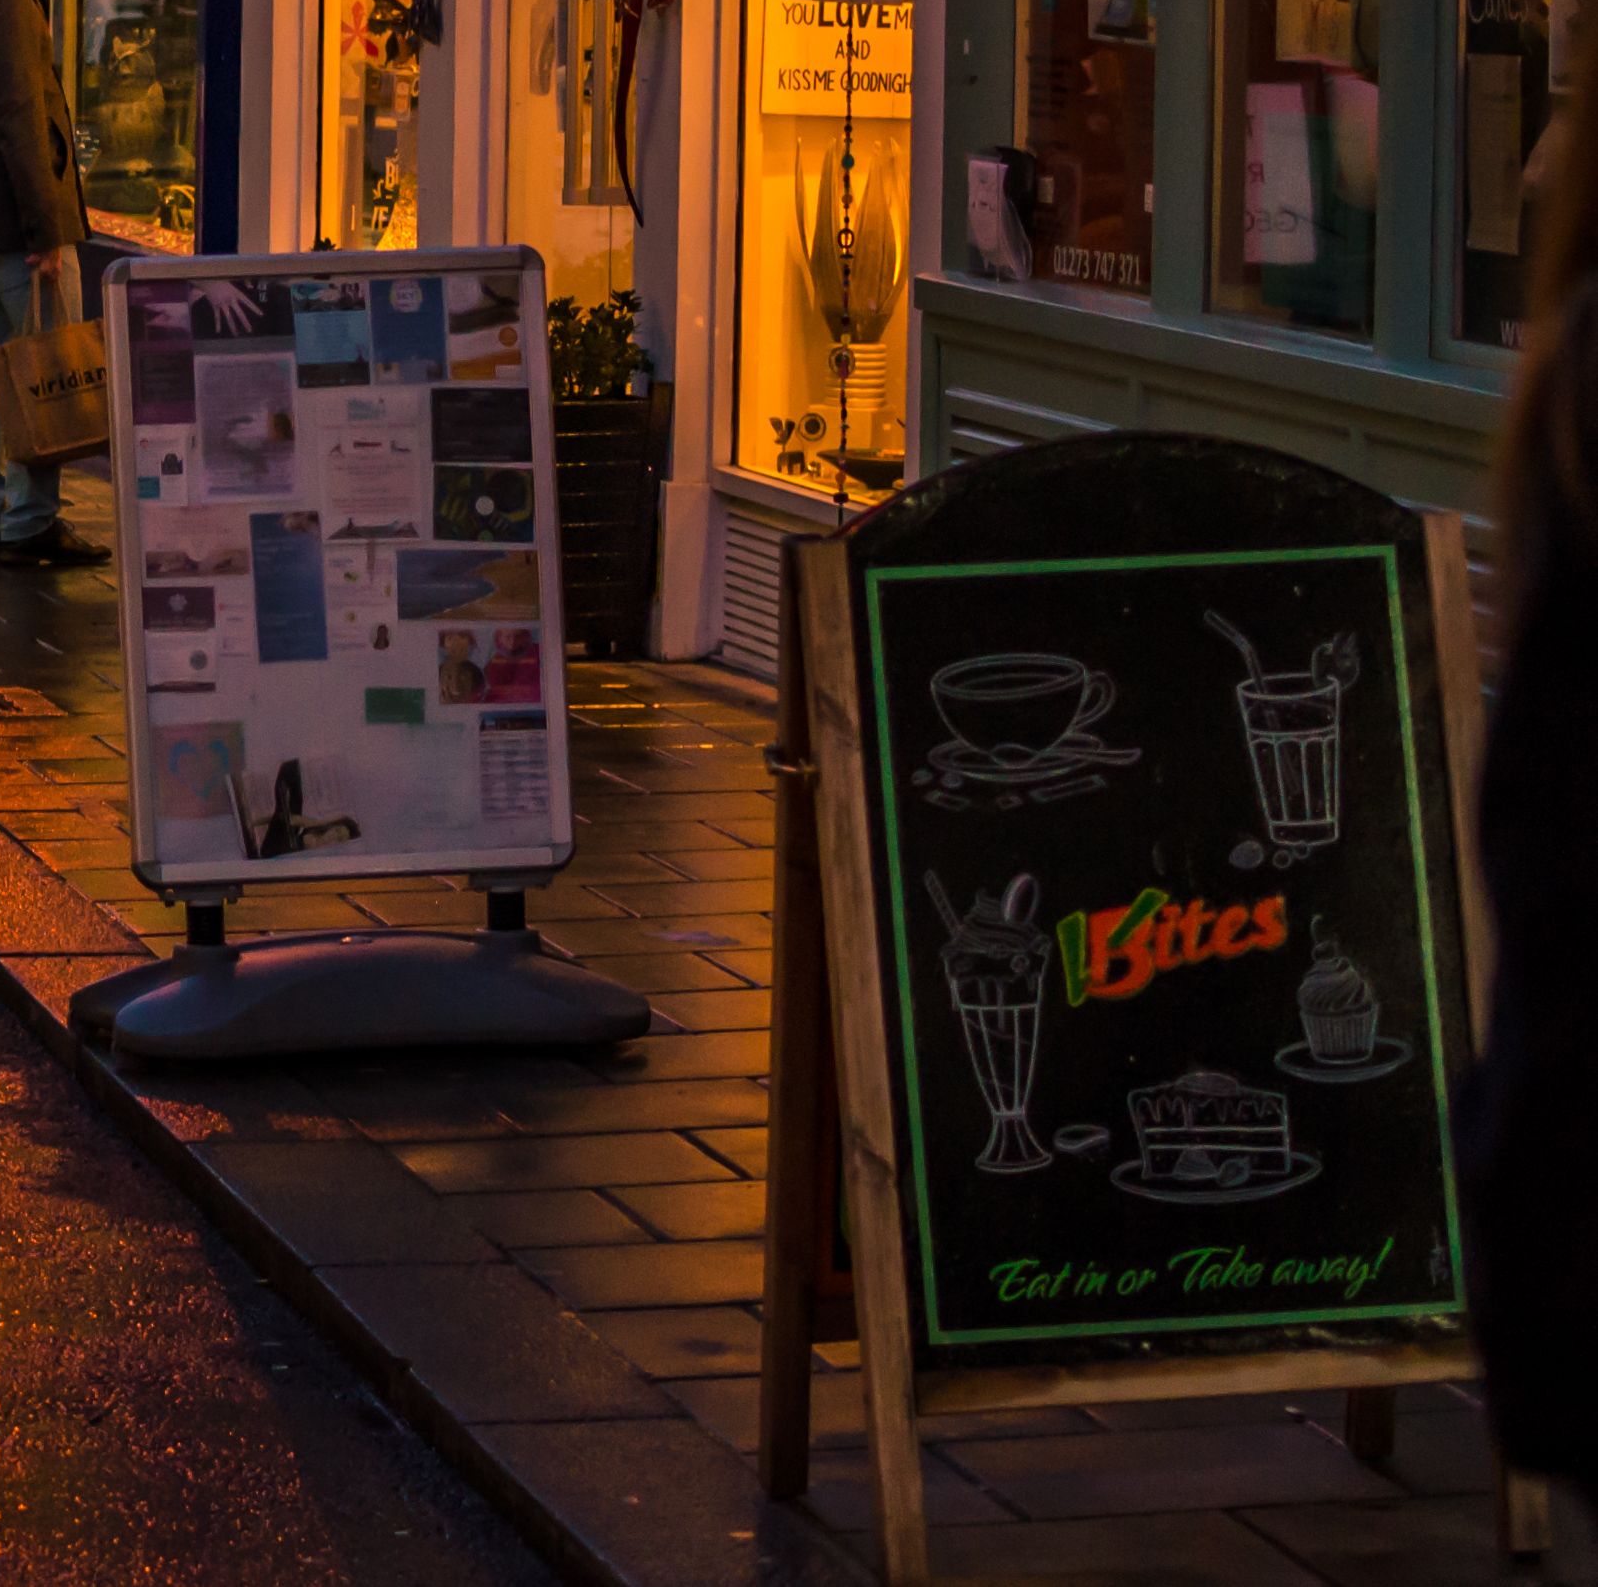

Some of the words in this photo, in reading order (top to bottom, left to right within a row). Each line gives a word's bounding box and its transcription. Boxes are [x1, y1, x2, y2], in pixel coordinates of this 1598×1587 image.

[781, 2, 815, 26] YOU
[817, 1, 891, 29] LOVE
[834, 39, 871, 60] AND
[777, 68, 810, 91] KISS
[813, 69, 836, 91] ME
[1053, 244, 1090, 279] 01273
[988, 1258, 1071, 1301] Eat
[1072, 1260, 1108, 1297] in
[1116, 1267, 1157, 1296] or
[1167, 1244, 1263, 1294] Take
[1270, 1236, 1395, 1299] away!
